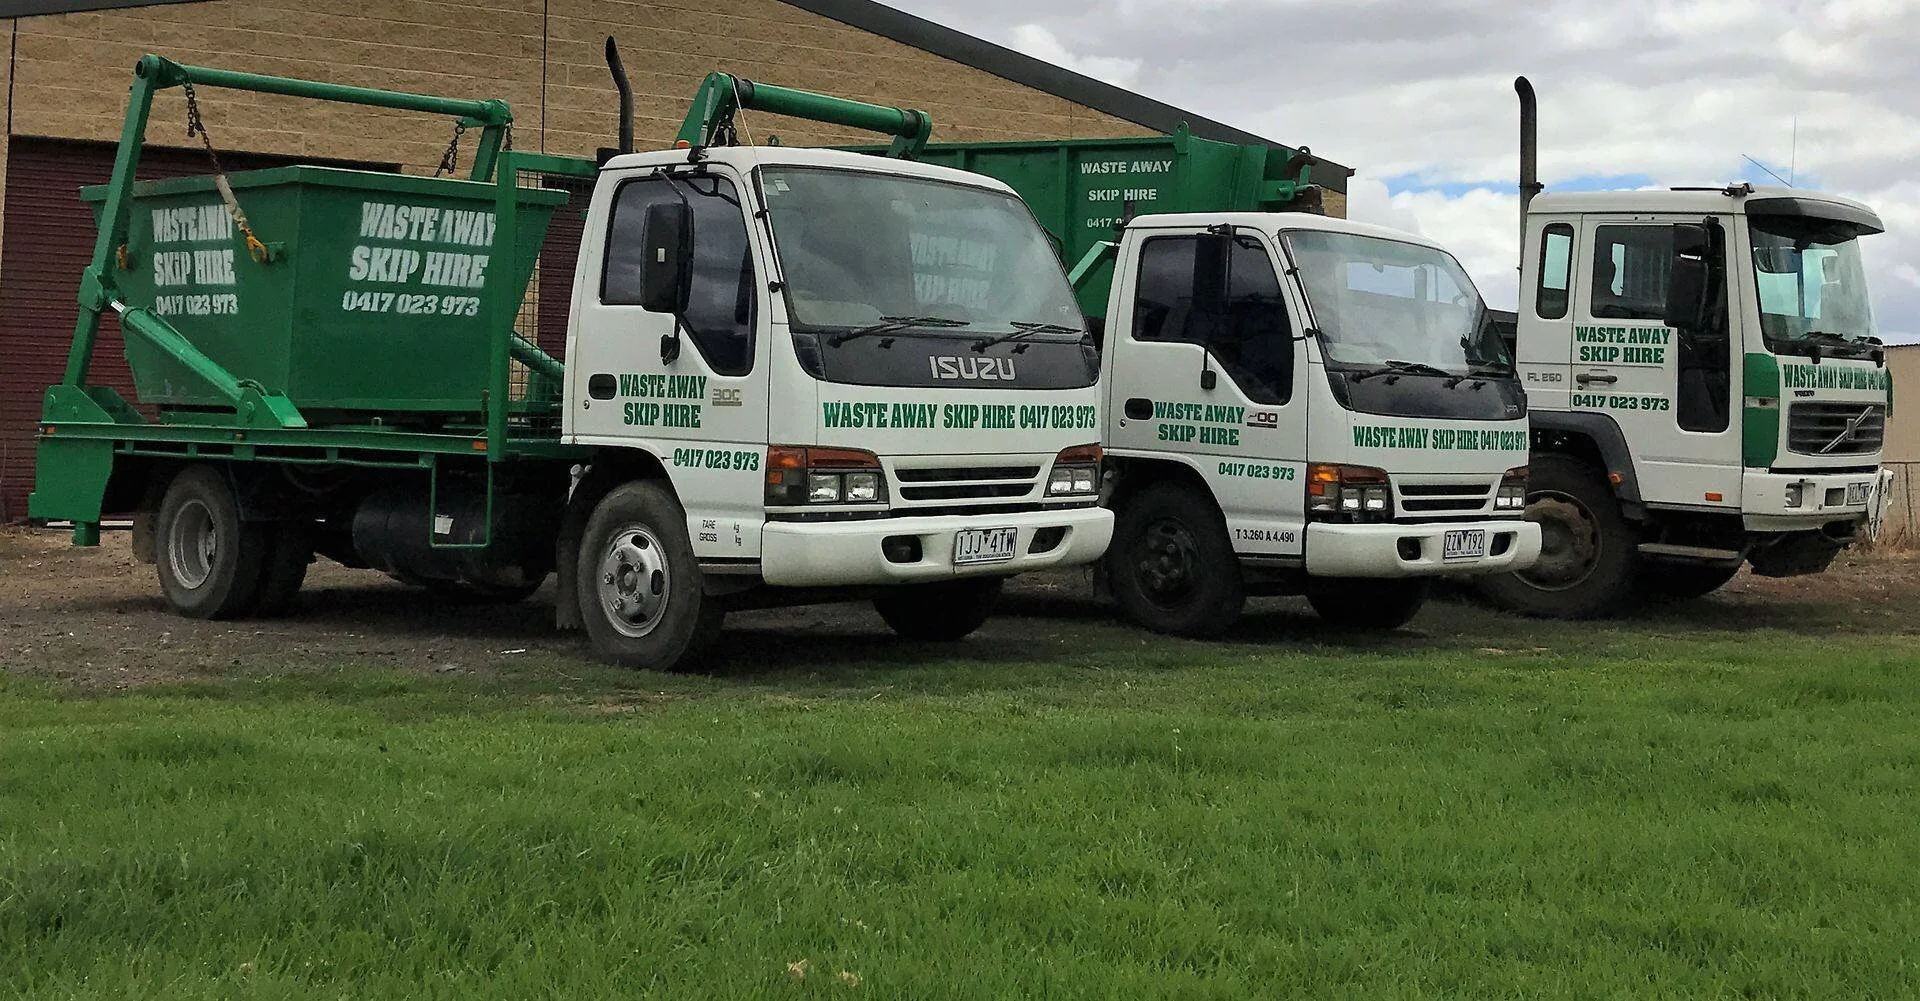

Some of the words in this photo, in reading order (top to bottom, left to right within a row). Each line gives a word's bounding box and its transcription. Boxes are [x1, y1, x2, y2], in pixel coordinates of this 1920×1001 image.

[1081, 162, 1126, 173] WASTE
[1131, 161, 1172, 173] AWAY
[1088, 189, 1120, 201] SKIP
[1124, 189, 1157, 200] HIRE
[152, 206, 197, 242] WASTE
[198, 204, 233, 240] AWAY
[360, 202, 439, 239] WASTE
[438, 209, 497, 247] AWAY
[1087, 218, 1112, 228] 0417
[154, 252, 191, 287] SKIP
[194, 249, 236, 285] HIRE
[349, 246, 419, 284] SKIP
[421, 251, 490, 288] HIRE
[156, 295, 183, 315] 0417
[186, 294, 210, 316] 023
[212, 293, 239, 315] 973
[342, 291, 395, 313] 0417
[396, 294, 438, 314] 023
[441, 296, 480, 316] 973
[1575, 326, 1625, 344] WASTE
[1628, 328, 1671, 345] AWAY
[1580, 346, 1619, 362] SKIP
[1623, 347, 1665, 363] HIRE
[929, 355, 1016, 381] ISUZU
[1527, 372, 1540, 381] FL
[1783, 364, 1816, 388] WASTE
[1818, 365, 1837, 388] AWAY
[620, 374, 665, 398] WASTE
[667, 375, 707, 399] AWAY
[1154, 402, 1202, 421] WASTE
[1204, 405, 1245, 424] AWAY
[1573, 394, 1606, 408] 0417
[1609, 396, 1638, 409] 023
[1641, 397, 1670, 411] 973
[624, 402, 660, 426] SKIP
[663, 404, 701, 428] HIRE
[823, 402, 887, 428] WASTE
[890, 403, 938, 428] AWAY
[943, 404, 979, 429] SKIP
[982, 405, 1015, 429] HIRE
[1020, 405, 1049, 429] 0417
[1051, 405, 1074, 429] 023
[1076, 406, 1096, 429] 973
[1247, 412, 1278, 423] 00
[1158, 424, 1196, 442] SKIP
[1200, 426, 1239, 446] HIRE
[1353, 426, 1396, 448] WASTE
[1398, 427, 1429, 449] AWAY
[1432, 429, 1455, 450] SKIP
[1457, 429, 1479, 450] HIRE
[1480, 430, 1499, 450] 0417
[1500, 430, 1515, 450] 023
[673, 448, 704, 468] 0417
[705, 450, 730, 469] 023
[733, 452, 760, 471] 973
[1218, 462, 1243, 476] 0417
[1247, 465, 1269, 478] 023
[1272, 467, 1295, 481] 973
[700, 532, 718, 542] GROSS
[702, 519, 716, 529] TARE
[733, 521, 740, 533] kg
[1235, 528, 1242, 539] T
[1243, 529, 1264, 541] 3.260
[1265, 530, 1272, 542] A
[1272, 531, 1295, 543] 4.490
